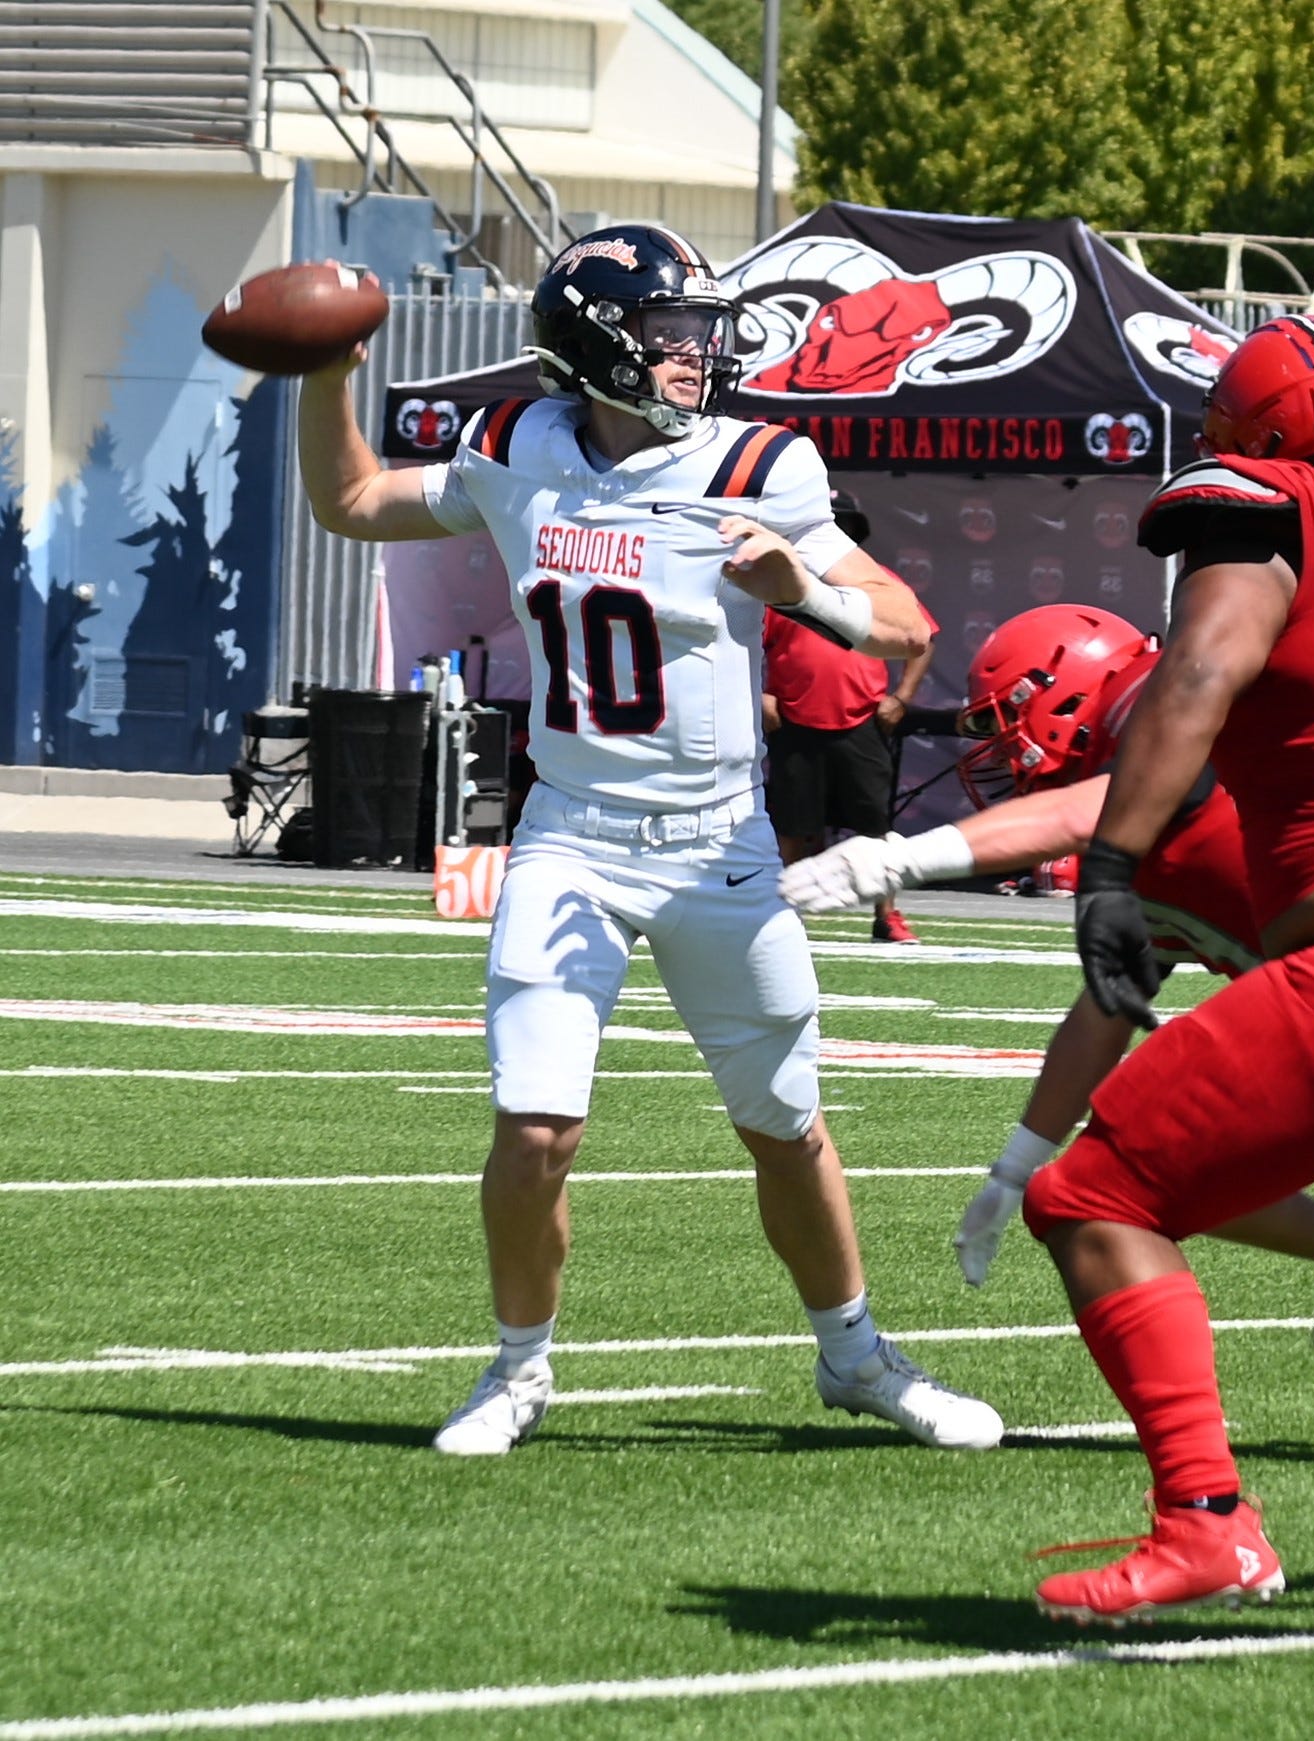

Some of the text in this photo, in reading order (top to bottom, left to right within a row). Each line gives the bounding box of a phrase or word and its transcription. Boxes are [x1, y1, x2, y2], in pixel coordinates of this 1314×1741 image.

[783, 416, 1064, 460] AN FRANCISCO
[536, 524, 645, 578] SEQUOIAS
[526, 579, 667, 735] 10
[436, 846, 507, 918] 50
